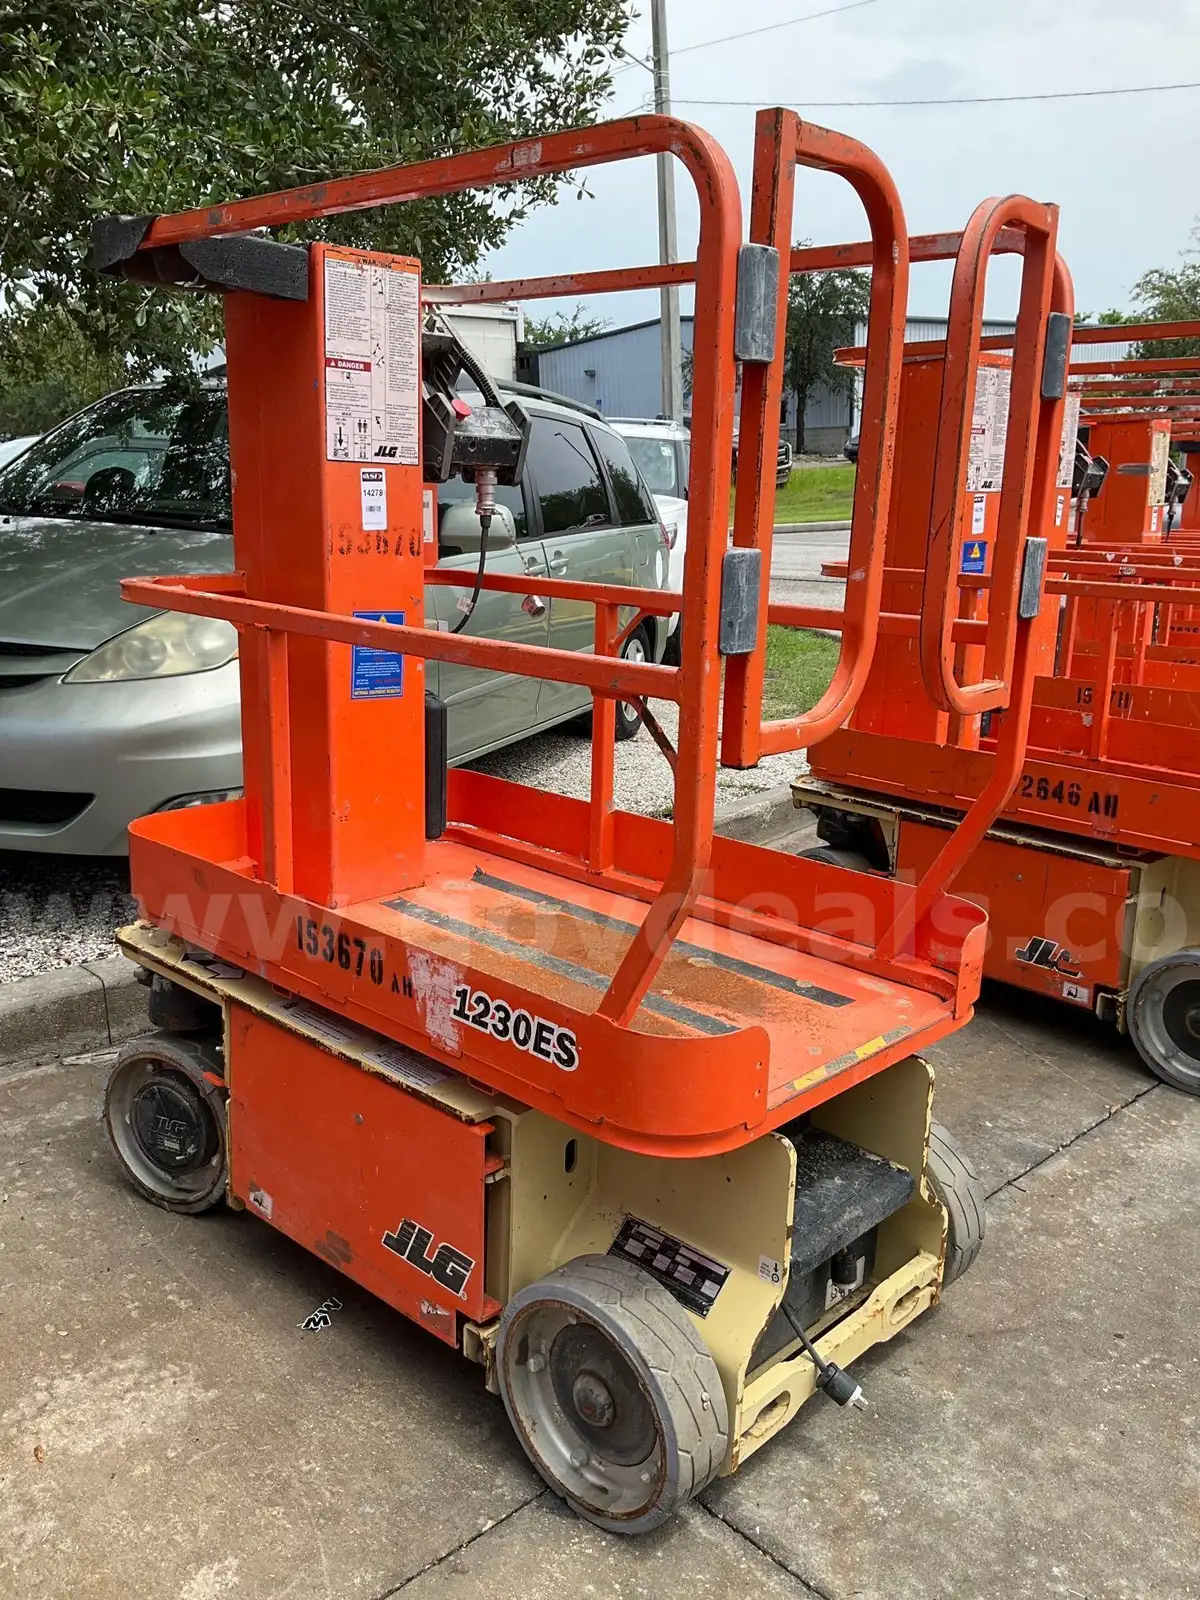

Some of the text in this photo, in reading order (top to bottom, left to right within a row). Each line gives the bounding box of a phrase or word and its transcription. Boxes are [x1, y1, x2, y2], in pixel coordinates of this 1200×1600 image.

[337, 360, 365, 370] DANGER
[374, 445, 398, 458] JLG
[363, 489, 384, 497] 14278
[1014, 774, 1082, 807] 2646
[296, 915, 384, 985] 153670
[451, 986, 579, 1071] 1230ES
[381, 1217, 476, 1297] JLG
